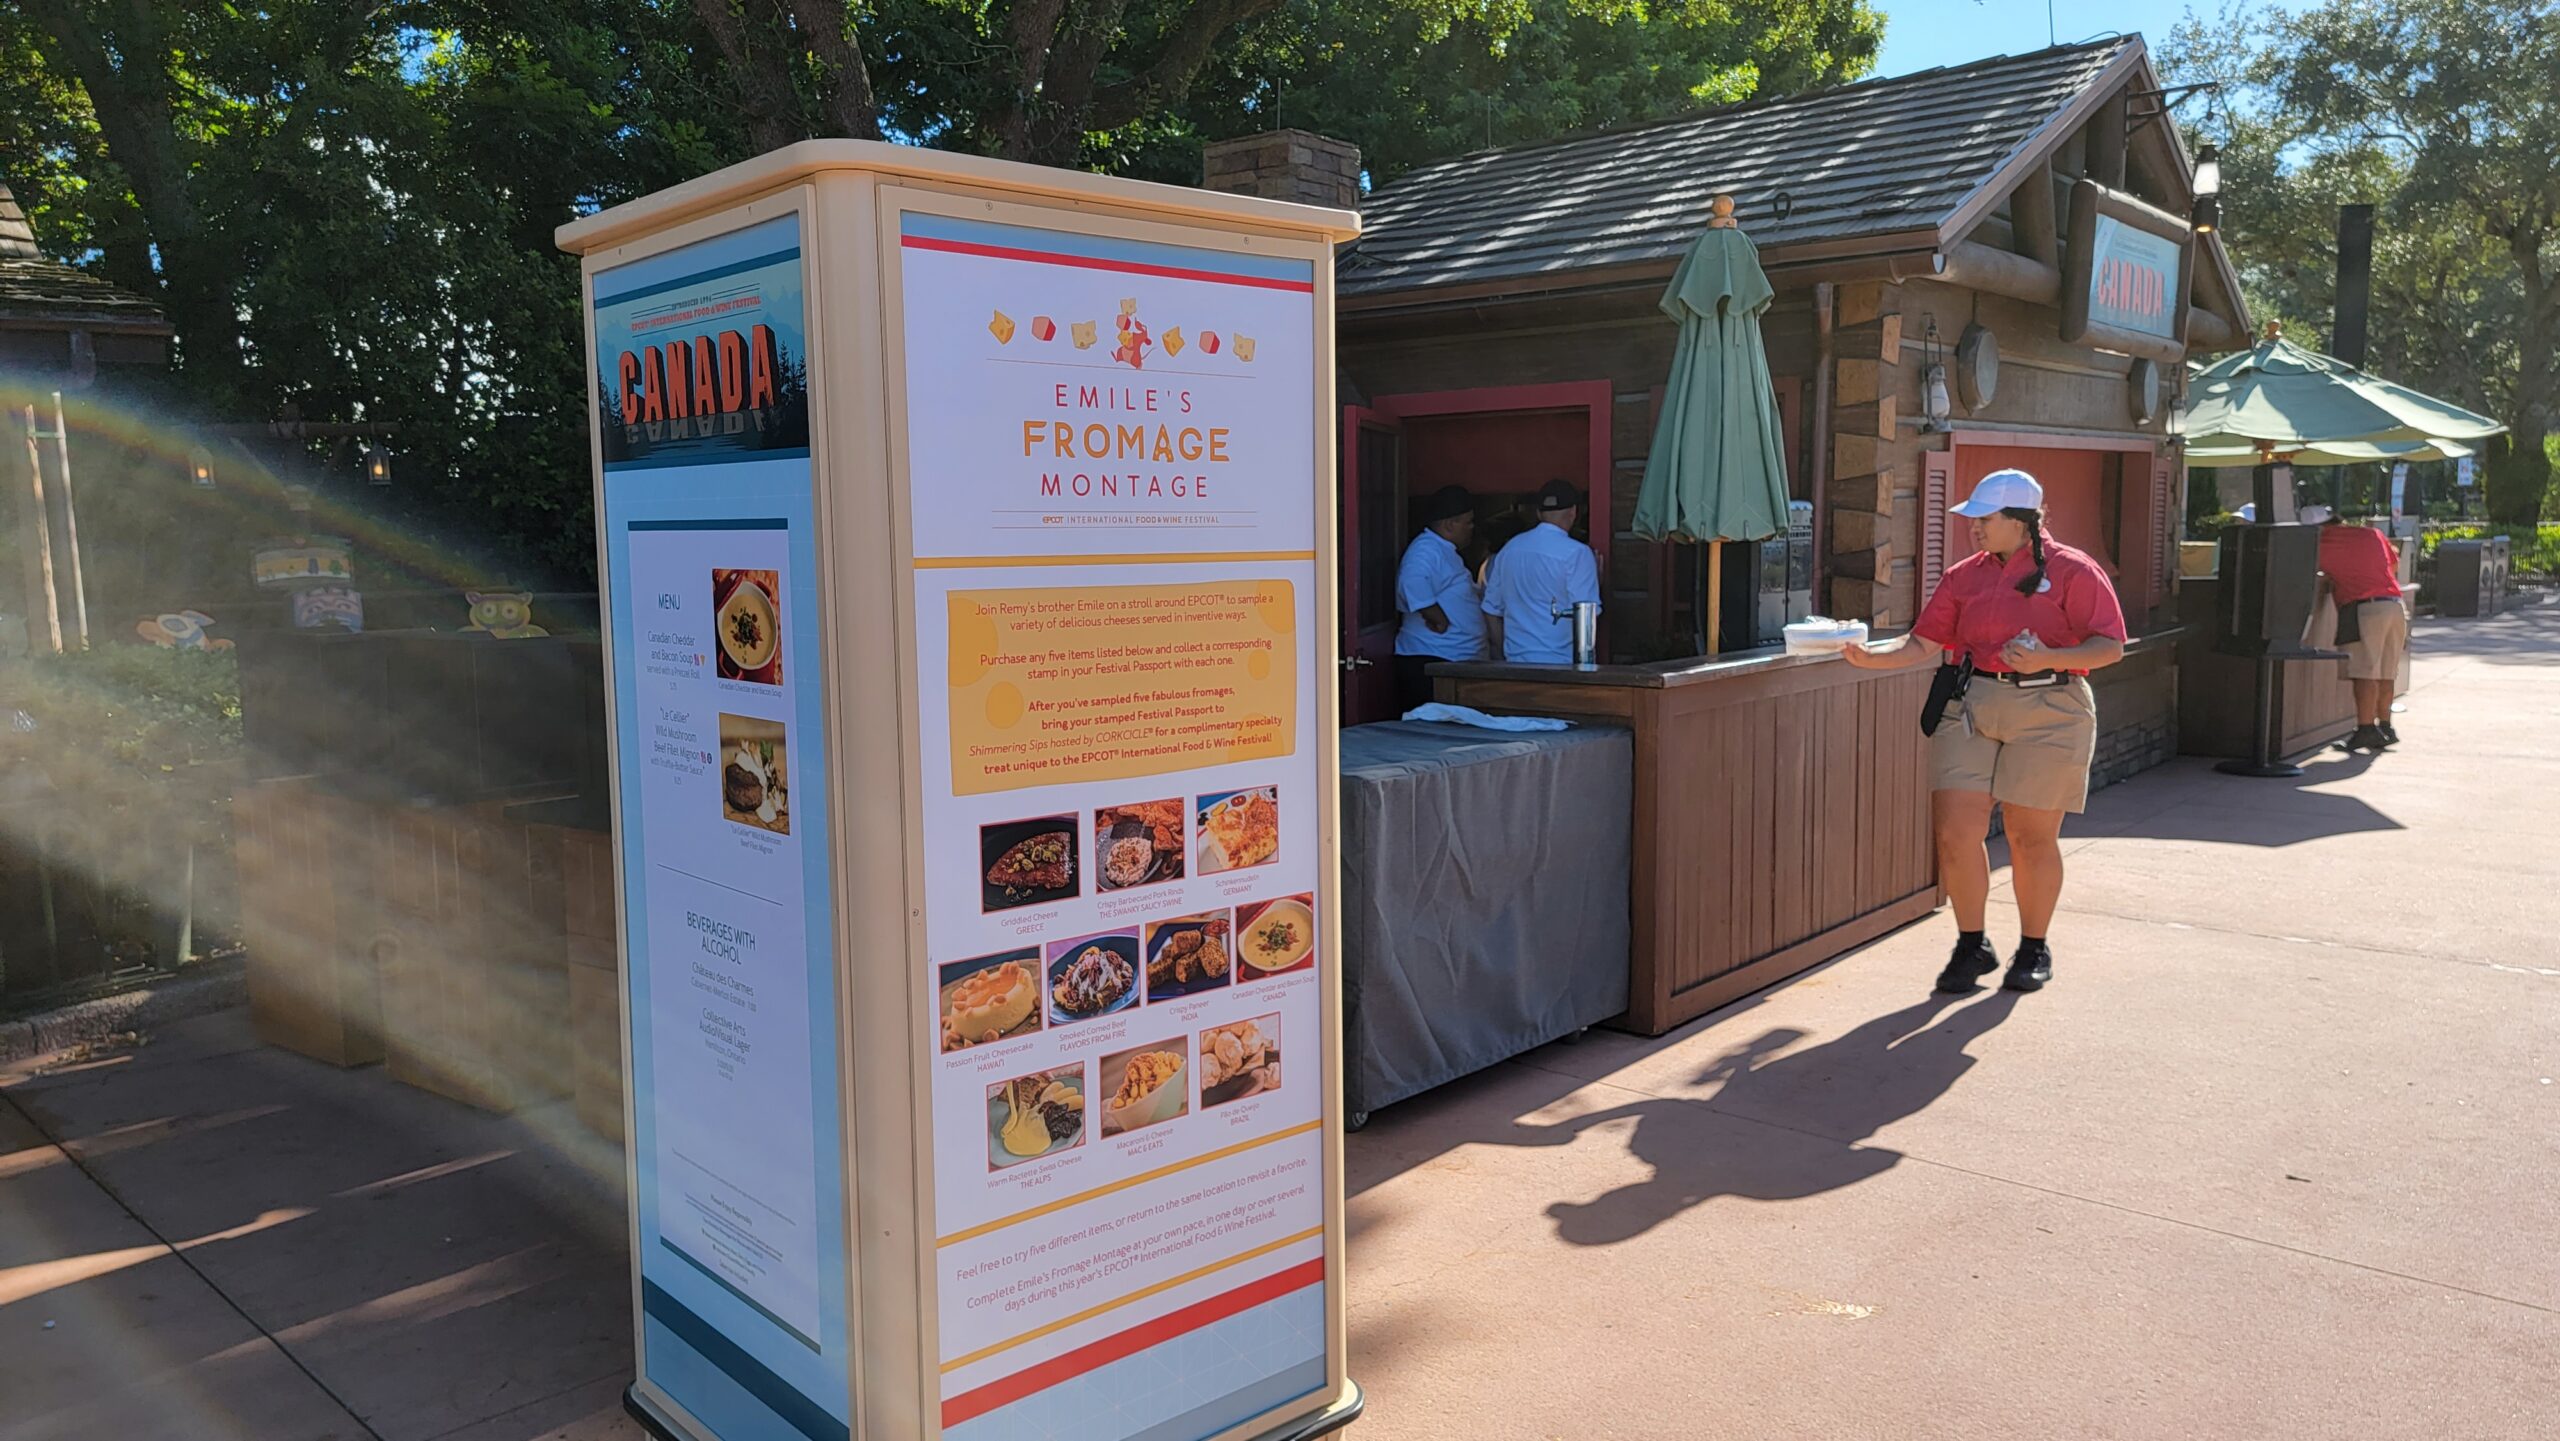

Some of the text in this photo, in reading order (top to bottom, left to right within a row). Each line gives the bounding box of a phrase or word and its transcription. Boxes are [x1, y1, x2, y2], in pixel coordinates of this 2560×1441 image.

[2098, 256, 2165, 317] CANADA
[619, 324, 779, 424] CANADA
[1055, 384, 1192, 413] EMILE'S
[1023, 420, 1230, 462] FROMAGE
[1041, 474, 1207, 498] MONTAGE
[1043, 516, 1064, 524] EPCOT
[1067, 516, 1133, 524] INTERNATIONAL
[659, 594, 680, 610] MENU
[975, 605, 997, 615] Join
[1000, 602, 1035, 616] Remy's
[1038, 601, 1074, 612] brother
[1078, 600, 1104, 611] Emile
[1107, 601, 1119, 609] on
[1129, 598, 1152, 608] stroll
[1155, 597, 1185, 607] around
[1227, 596, 1235, 604] to
[1238, 594, 1267, 606] sample
[1010, 612, 1247, 632] variety of delicious cheeses served in inventive ways.
[648, 631, 695, 646] Canadian Cheddar
[652, 649, 693, 668] and Bacon Soup
[981, 653, 1026, 665] Purchase
[1029, 653, 1046, 664] any
[1049, 650, 1065, 661] five
[1069, 650, 1094, 659] items
[1097, 646, 1123, 658] listed
[1126, 645, 1153, 655] below
[1155, 645, 1171, 654] and
[1174, 642, 1204, 652] collect
[1213, 638, 1271, 651] corresponding
[1028, 656, 1235, 680] stamp in your Festival Passport with each one.
[1028, 687, 1235, 712] After you've sampled five fabulous fromages,
[1042, 705, 1224, 730] bring your stamped Festival Passport to
[969, 742, 1026, 756] Shimmering
[1030, 739, 1048, 750] Sips
[1050, 735, 1081, 747] hosted
[1084, 735, 1094, 746] by
[1155, 727, 1169, 736] for
[1178, 721, 1244, 734] complimentary
[1246, 715, 1282, 728] specialty
[984, 763, 1011, 774] treat
[1013, 760, 1047, 772] unique
[1050, 758, 1060, 766] to
[1063, 755, 1080, 765] the
[1121, 744, 1181, 758] International
[1183, 741, 1204, 751] Food
[1214, 737, 1235, 748] Wine
[1237, 733, 1272, 745] Festival!
[1223, 885, 1252, 896] GERMANY
[1001, 911, 1058, 927] Griddled Cheese
[1100, 897, 1183, 919] THE SWANKY SAUCY SWINE
[687, 911, 756, 951] BEVERAGES WITH
[1016, 923, 1045, 935] GREECE
[701, 936, 741, 965] ALCOHOL
[716, 973, 727, 986] des
[728, 975, 754, 997] Charmes
[702, 1007, 746, 1037] Collective Arts
[1059, 1019, 1127, 1042] Smoked Corned Beef
[1060, 1029, 1126, 1052] FLAVORS FROM FIRE
[946, 1042, 1033, 1069] Passion Fruit Cheesecake
[957, 1157, 1307, 1281] Feel free to try five different items, or return to the same location to revisit a favorite.
[967, 1184, 1305, 1309] Complete Emile's Fromage Montage at your own pace, in one day or over several
[1005, 1295, 1025, 1312] days
[1028, 1286, 1057, 1304] during
[1059, 1278, 1075, 1292] this
[1077, 1268, 1103, 1289] year's
[1141, 1235, 1193, 1261] International
[1195, 1227, 1216, 1244] Food
[1218, 1228, 1223, 1236] &
[1225, 1216, 1244, 1233] Wine
[1246, 1208, 1276, 1226] Festival.
